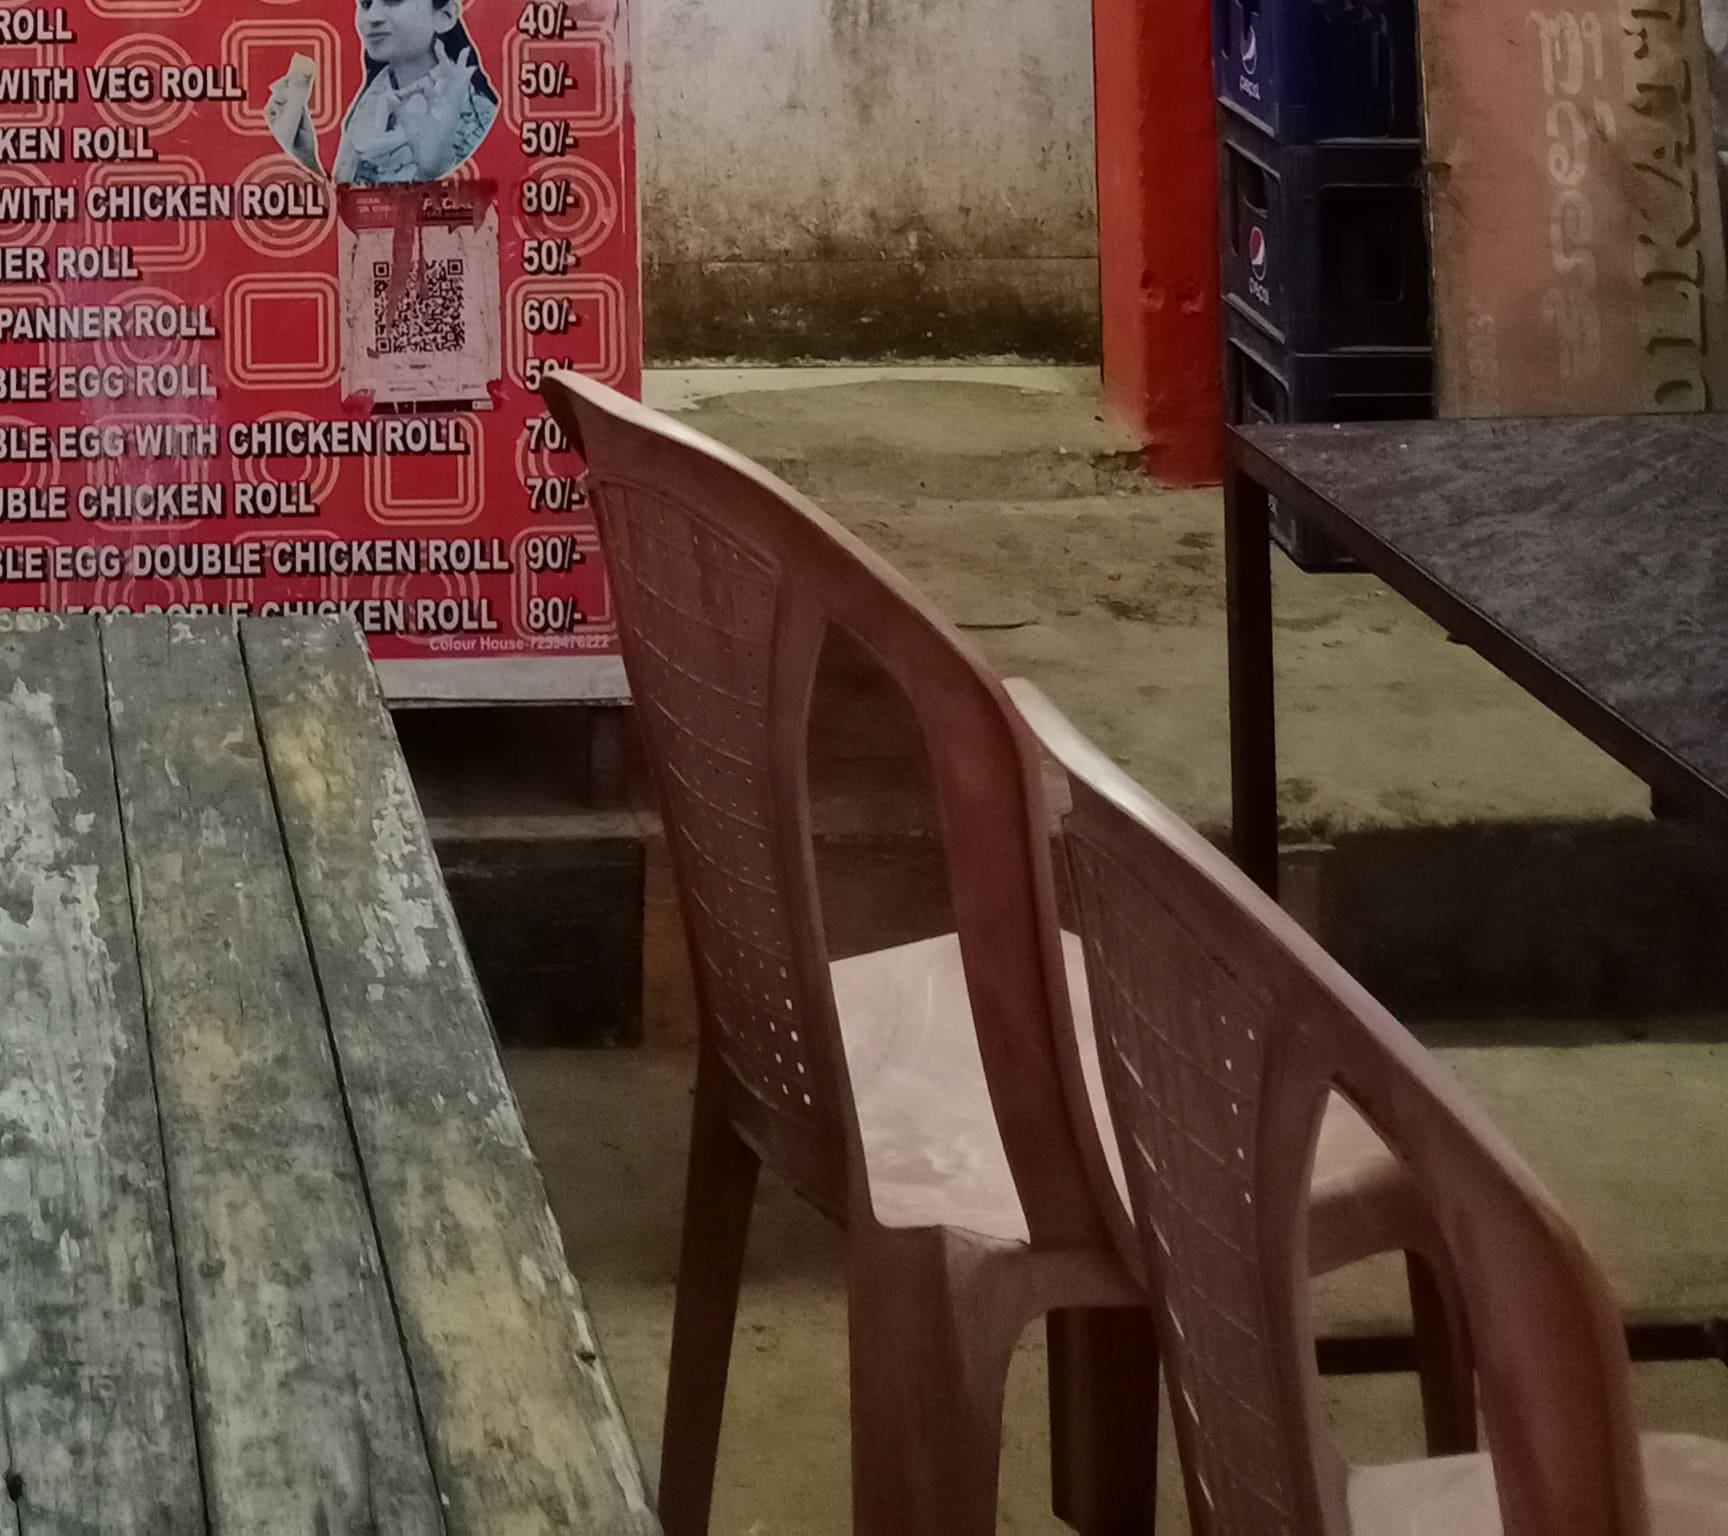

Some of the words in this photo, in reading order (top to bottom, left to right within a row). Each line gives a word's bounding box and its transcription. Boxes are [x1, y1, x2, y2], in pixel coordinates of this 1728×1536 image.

[87, 68, 151, 101] VEG
[161, 67, 245, 99] ROLL
[520, 62, 576, 95] 50/-
[1240, 73, 1261, 101] pepsi
[56, 247, 140, 280] ROLL
[523, 242, 576, 275] 50/-
[78, 485, 224, 519] CHICKEN
[234, 482, 317, 514] ROLL
[526, 478, 585, 511] 70/-
